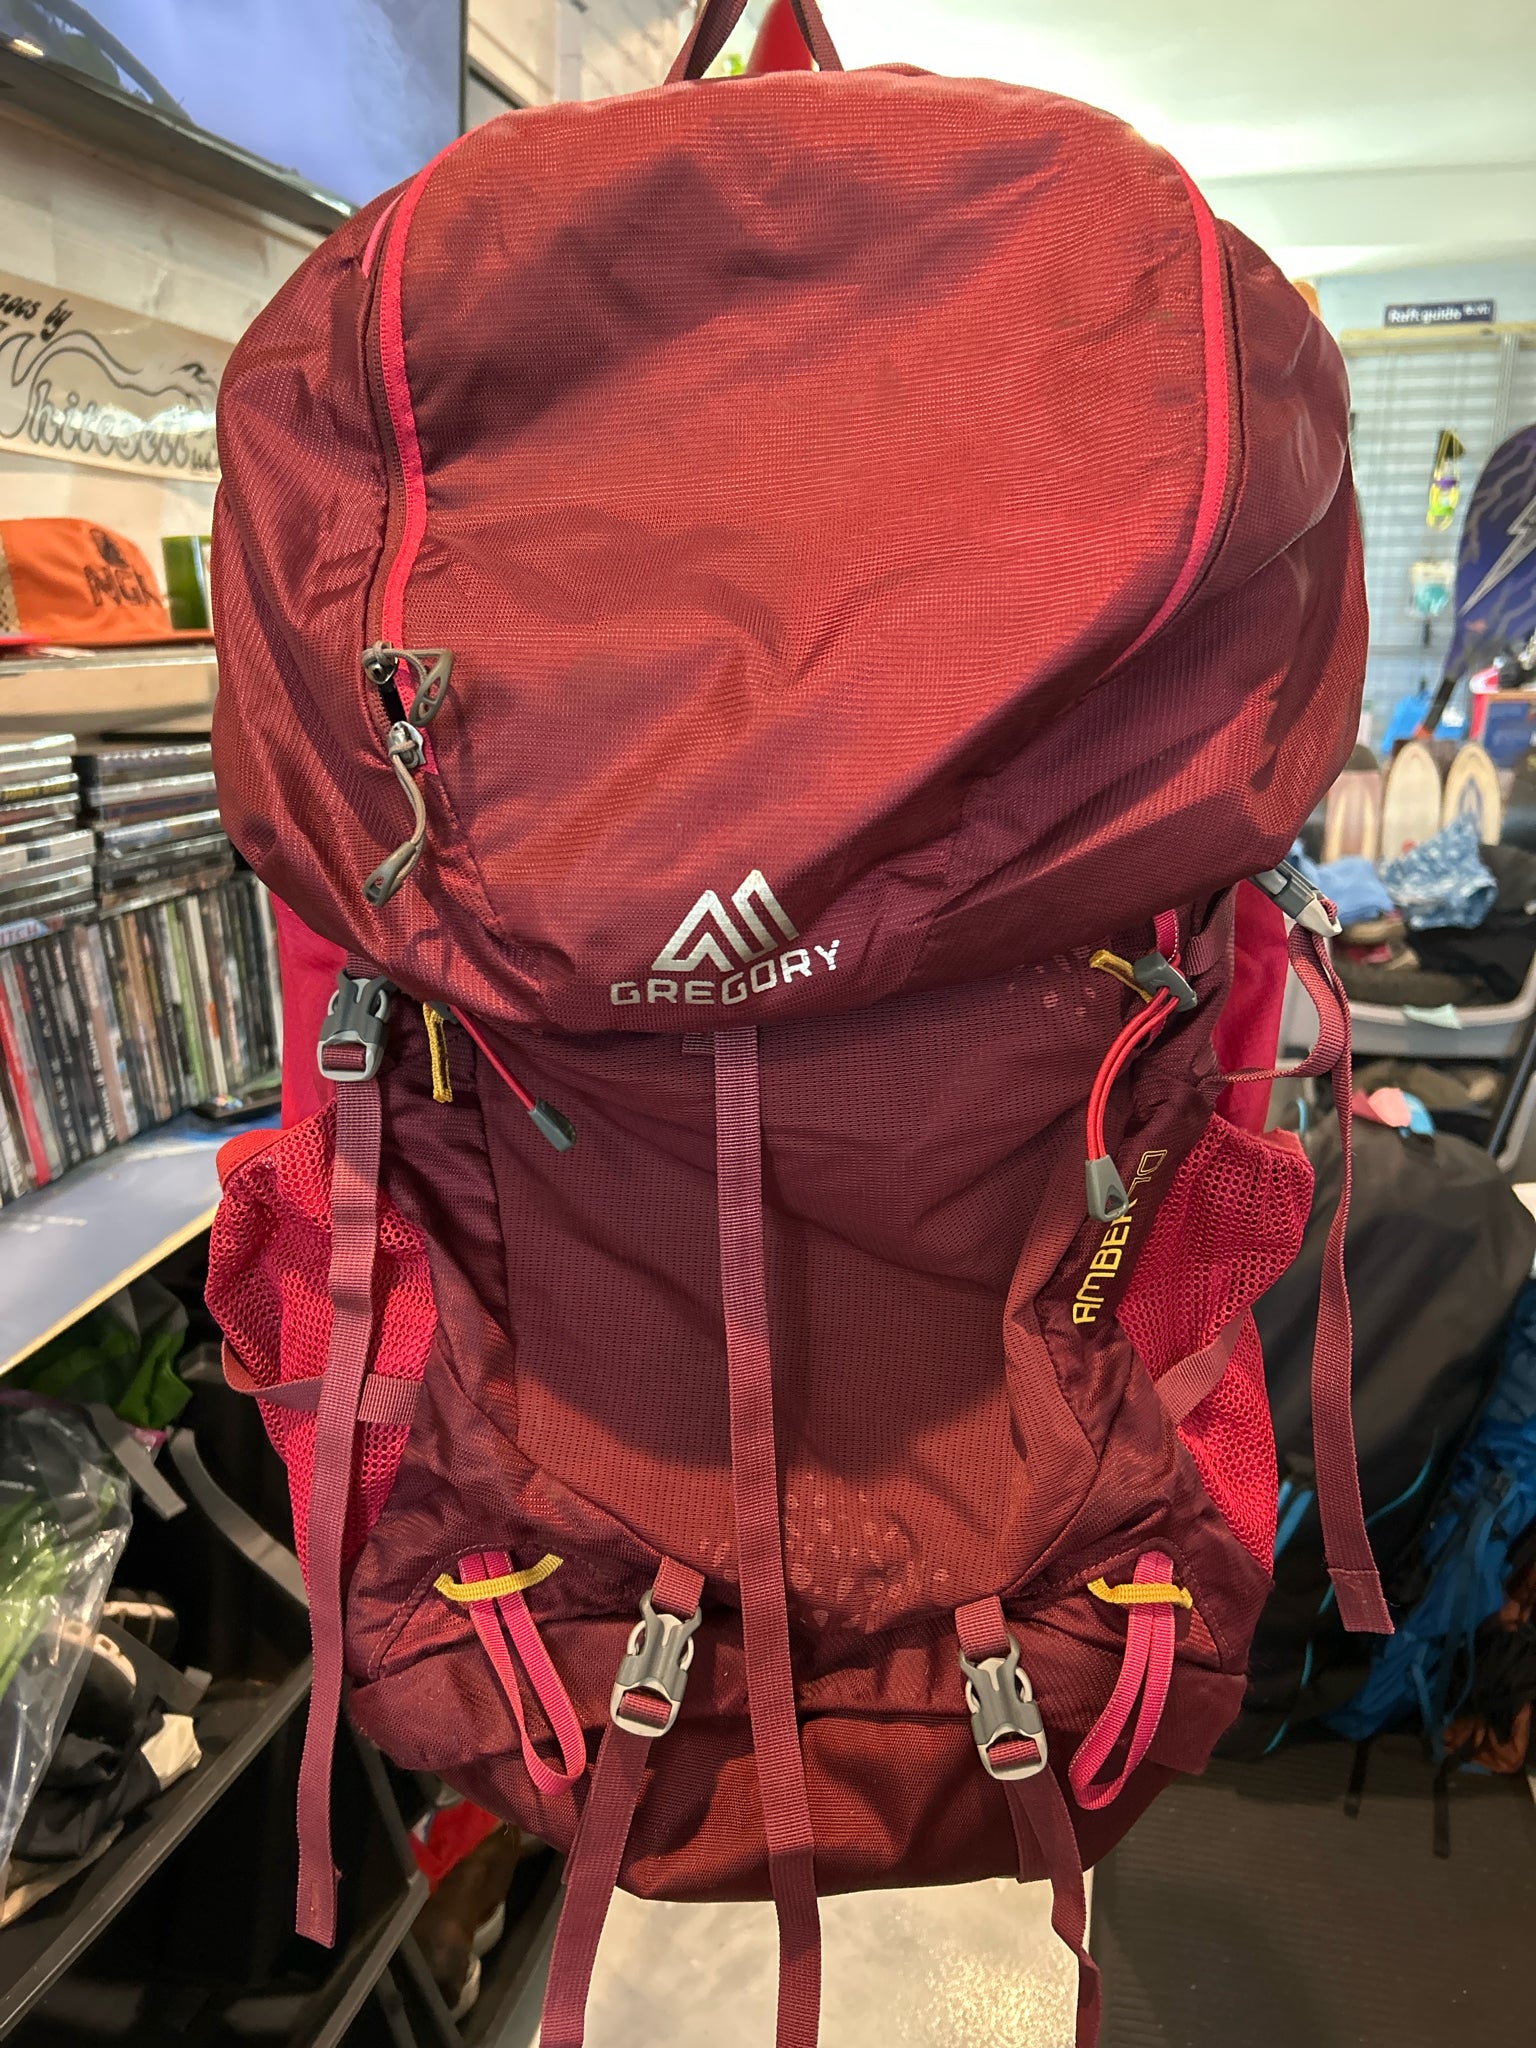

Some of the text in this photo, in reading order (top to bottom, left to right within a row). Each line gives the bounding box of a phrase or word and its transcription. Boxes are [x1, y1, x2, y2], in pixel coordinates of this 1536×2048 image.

[40, 299, 74, 342] by
[1420, 306, 1462, 324] guide
[610, 939, 841, 1006] GREGORY
